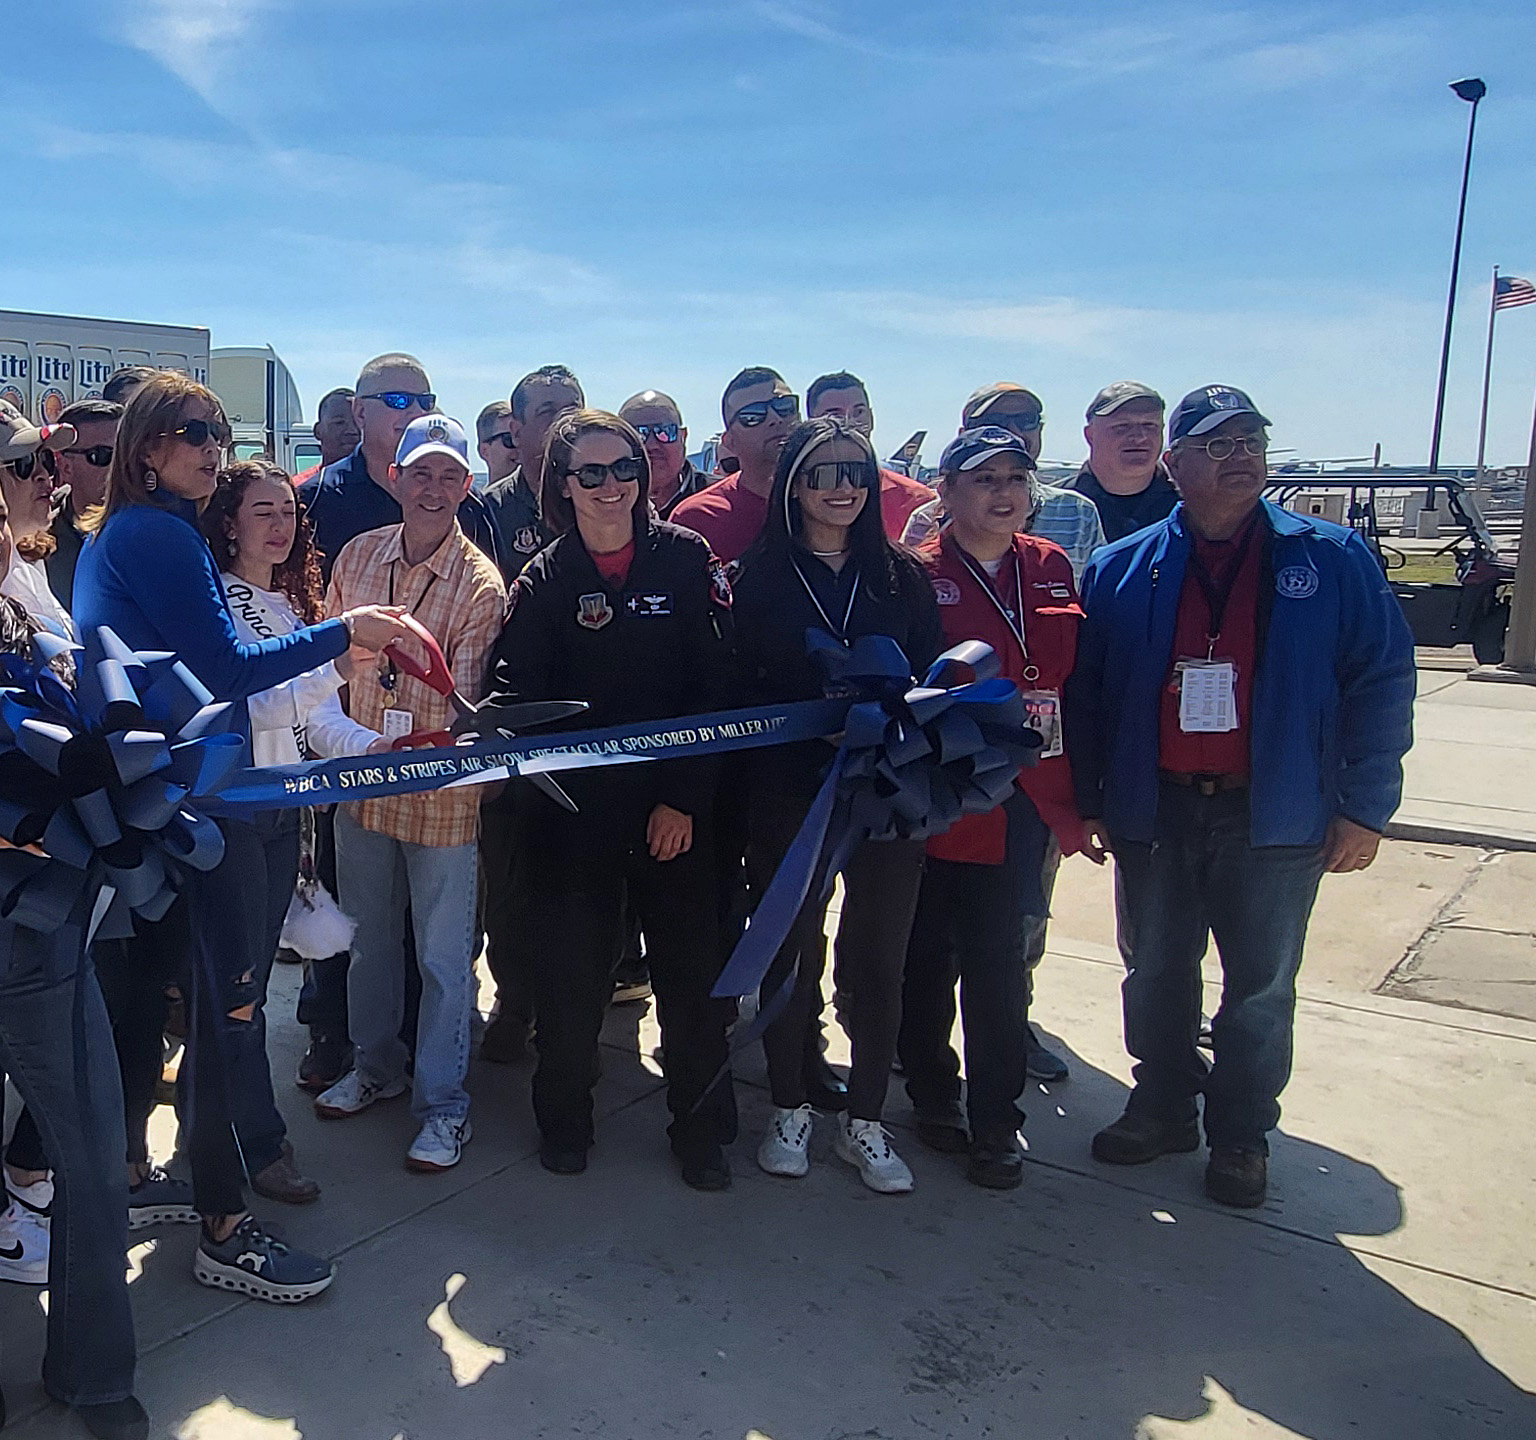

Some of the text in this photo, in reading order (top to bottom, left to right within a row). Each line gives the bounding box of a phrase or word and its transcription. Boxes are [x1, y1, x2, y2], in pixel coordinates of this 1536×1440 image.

[37, 356, 71, 385] Lite
[79, 359, 111, 388] Lite
[226, 584, 276, 639] Princ
[284, 774, 330, 794] WBCA
[339, 768, 383, 789] STARS
[387, 767, 398, 782] &
[401, 760, 457, 781] STRIPES
[460, 756, 484, 773] AIR
[484, 751, 527, 769] SHOW
[623, 729, 697, 751] SPONSORED
[698, 727, 716, 742] BY
[718, 720, 764, 739] MILLER
